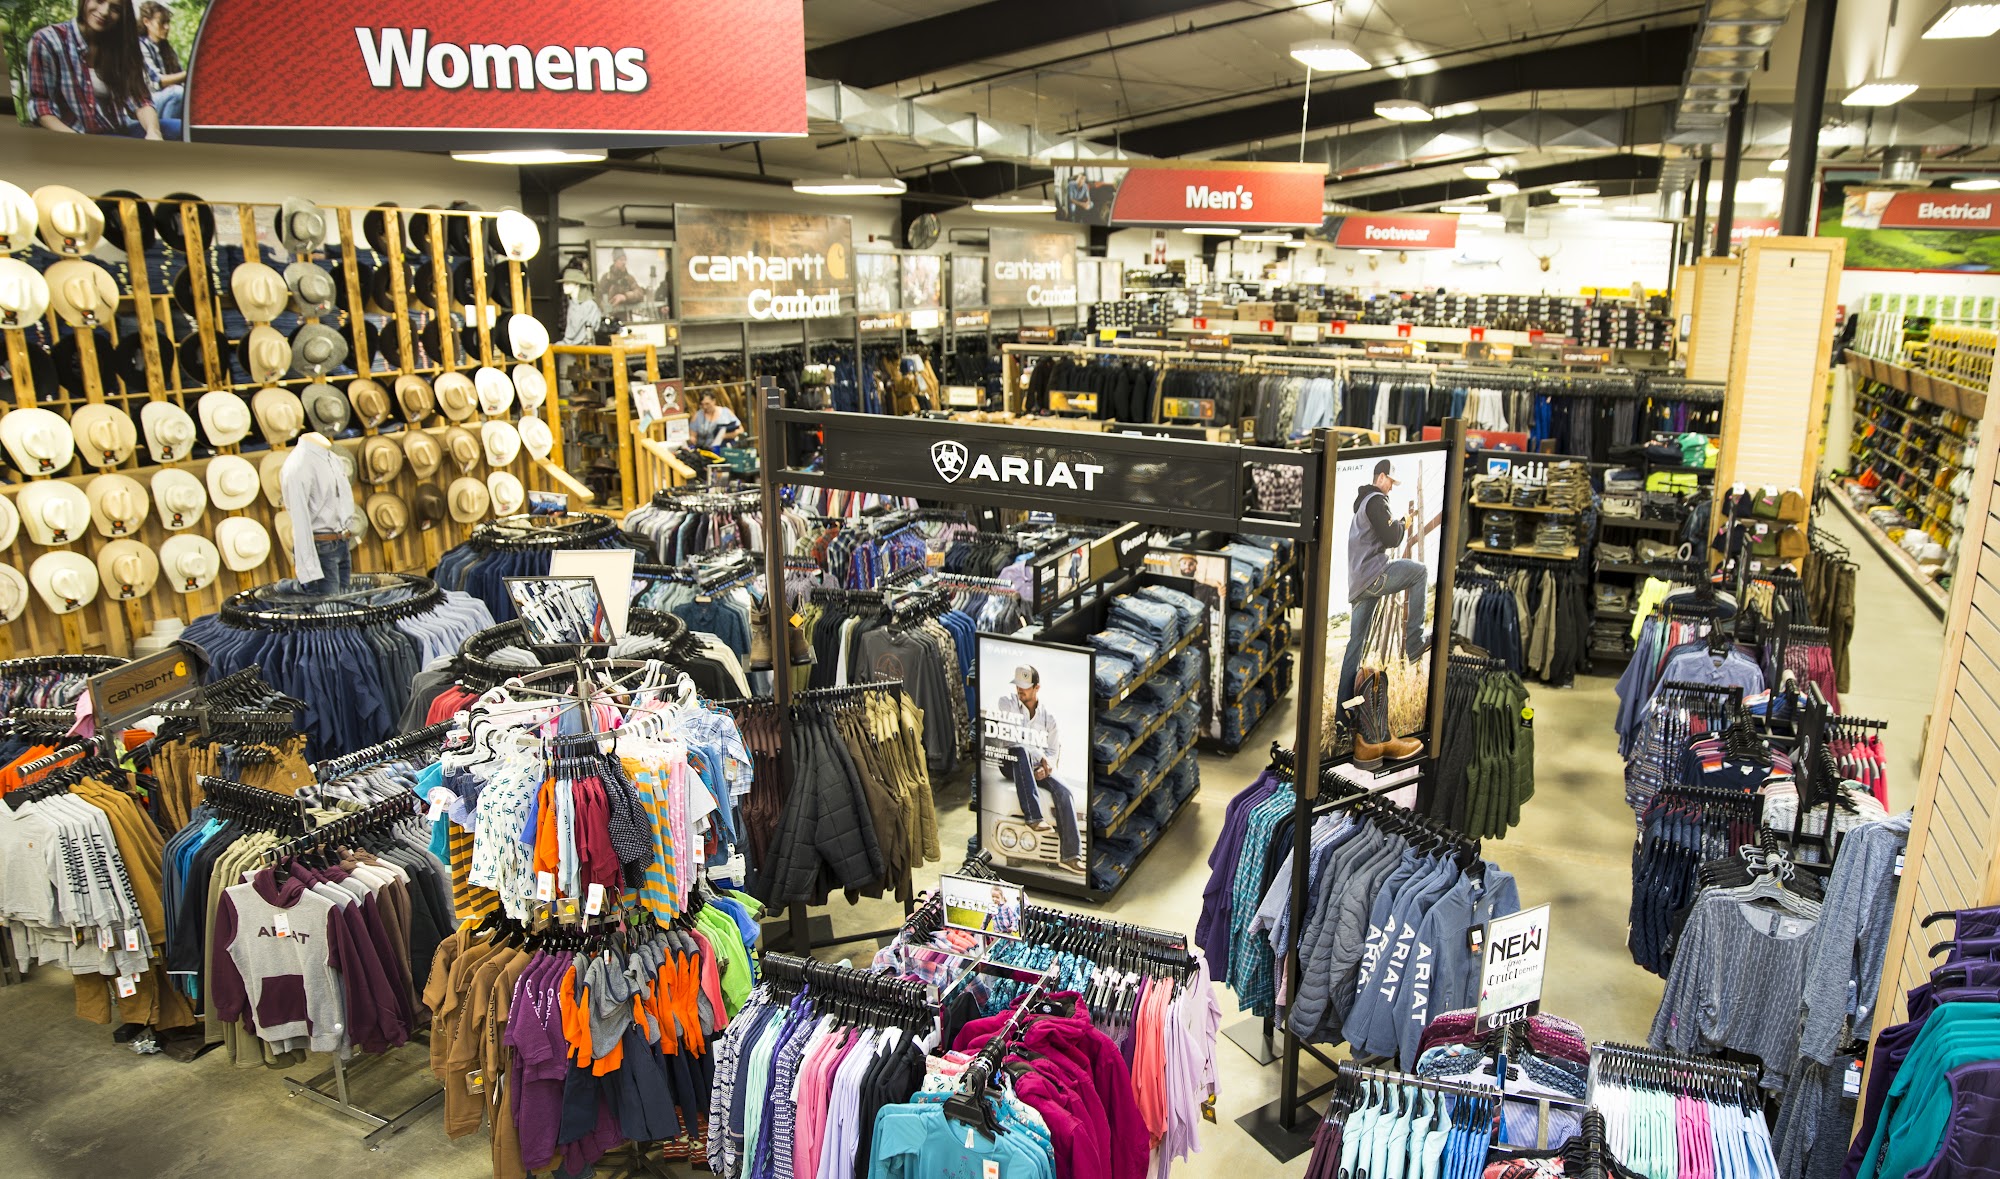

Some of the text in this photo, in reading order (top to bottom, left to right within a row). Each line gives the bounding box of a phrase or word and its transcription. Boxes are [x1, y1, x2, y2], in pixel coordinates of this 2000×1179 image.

[354, 27, 648, 93] Womens
[1185, 185, 1254, 210] Men's
[1917, 202, 1992, 220] Electrical
[1365, 225, 1430, 242] Footwear
[688, 250, 825, 283] carhartt
[994, 258, 1062, 281] carhartt
[747, 288, 841, 320] Carhartt
[860, 315, 895, 330] carhartt
[955, 312, 984, 326] carhartt
[1020, 329, 1049, 338] carhartt
[1190, 337, 1222, 346] carhartt
[1564, 353, 1601, 362] carhartt
[968, 454, 1104, 491] ARIAT
[1512, 461, 1549, 481] KÜ
[1127, 531, 1148, 552] ARIAT
[107, 670, 174, 705] carhartt
[985, 710, 1025, 726] ARIAT
[984, 719, 1049, 749] DENIM
[985, 745, 1009, 755] BECAUSE
[985, 750, 995, 758] FIT
[994, 751, 1019, 763] MATTERS
[945, 894, 999, 915] GIRLS
[257, 926, 310, 945] AAT
[1489, 928, 1542, 965] NEW
[1380, 922, 1416, 1003] ARIAT
[1411, 941, 1433, 1027] ARIAT
